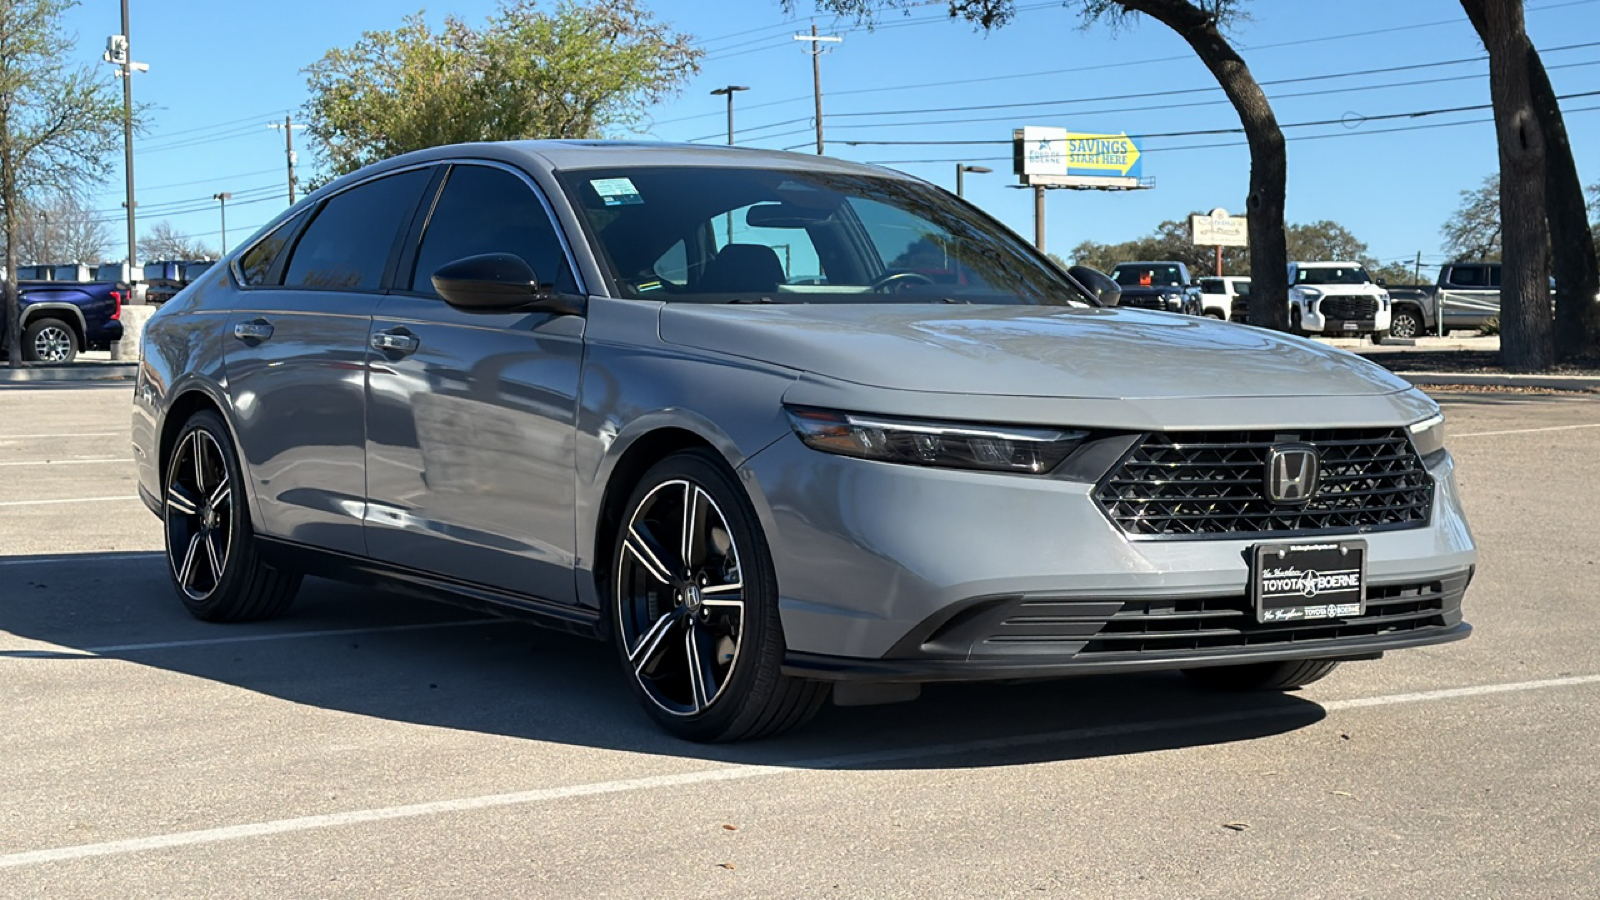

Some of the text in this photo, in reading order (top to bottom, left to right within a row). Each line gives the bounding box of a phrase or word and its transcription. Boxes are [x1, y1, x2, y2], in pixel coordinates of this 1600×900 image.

[1069, 139, 1128, 155] SAVINGS
[1069, 154, 1127, 165] START HERE
[1263, 574, 1359, 591] TOYOTA BOERNE
